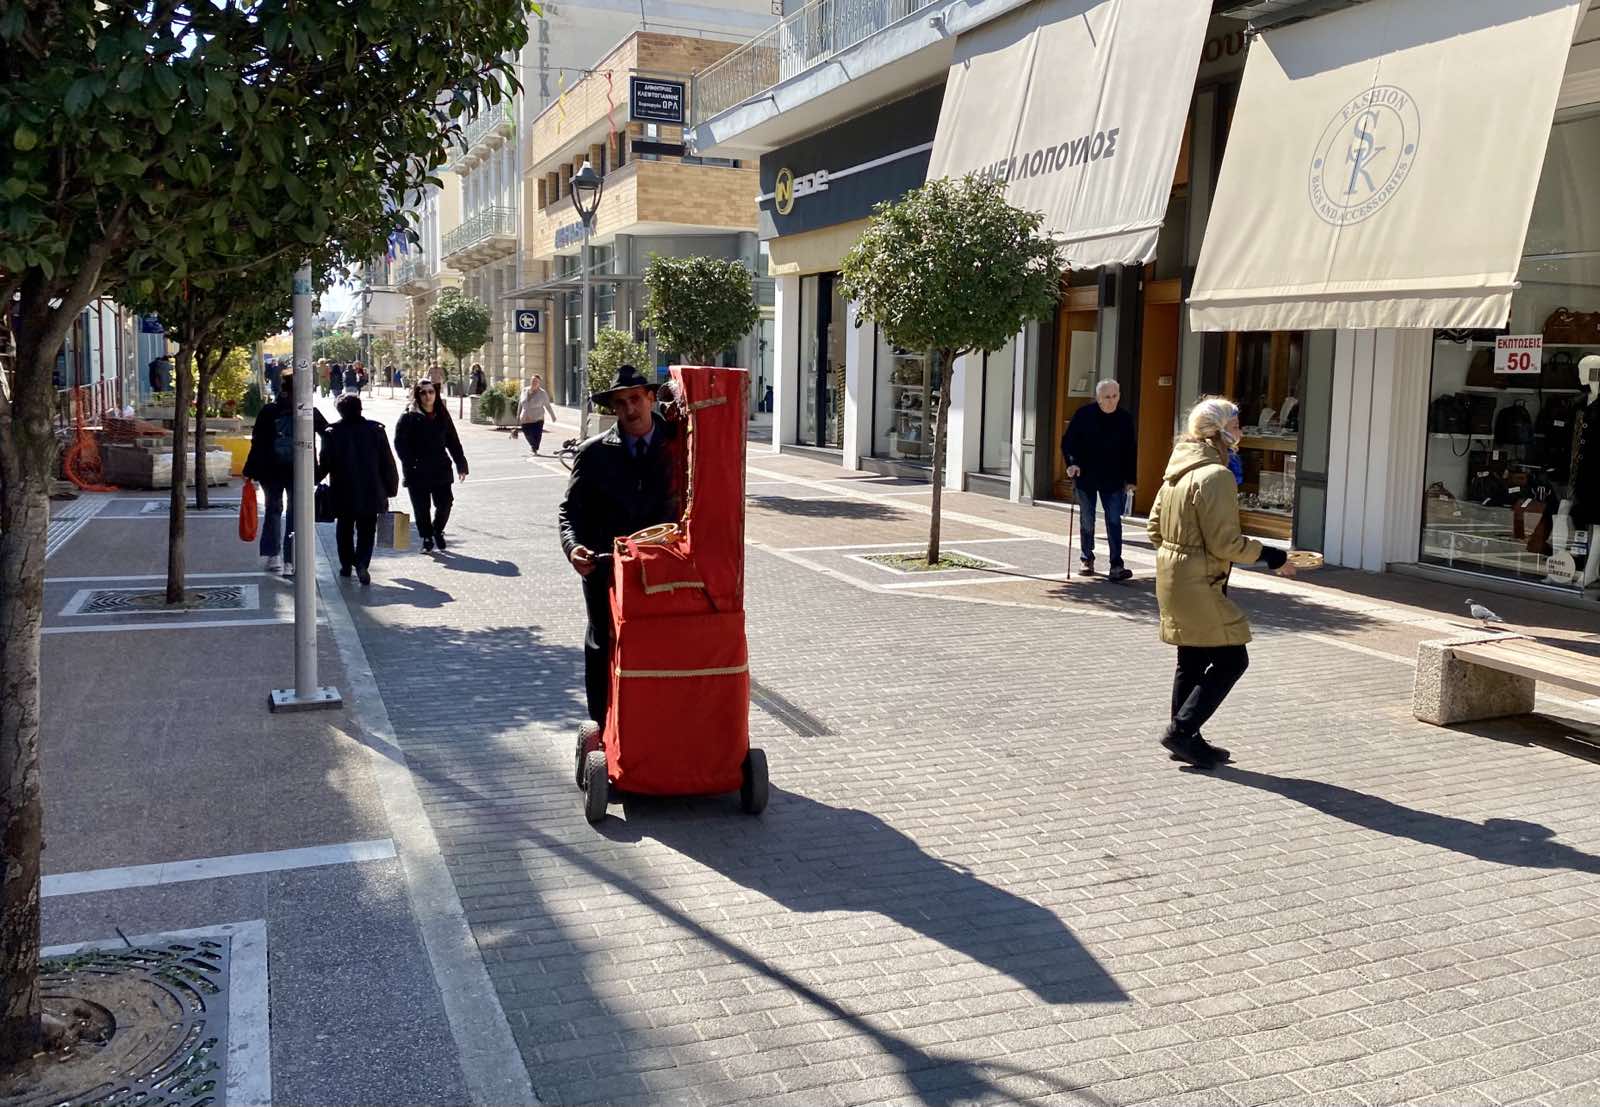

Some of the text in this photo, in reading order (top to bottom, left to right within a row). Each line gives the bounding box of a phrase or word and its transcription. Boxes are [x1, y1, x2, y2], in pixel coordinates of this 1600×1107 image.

[538, 20, 550, 96] REX
[662, 100, 678, 110] ΩΡΛ
[1342, 88, 1408, 121] FASHION
[1311, 162, 1408, 222] BAGS AND ACCESSORIES
[1497, 338, 1542, 349] ΕΚΠΤΩΣΕΙΣ
